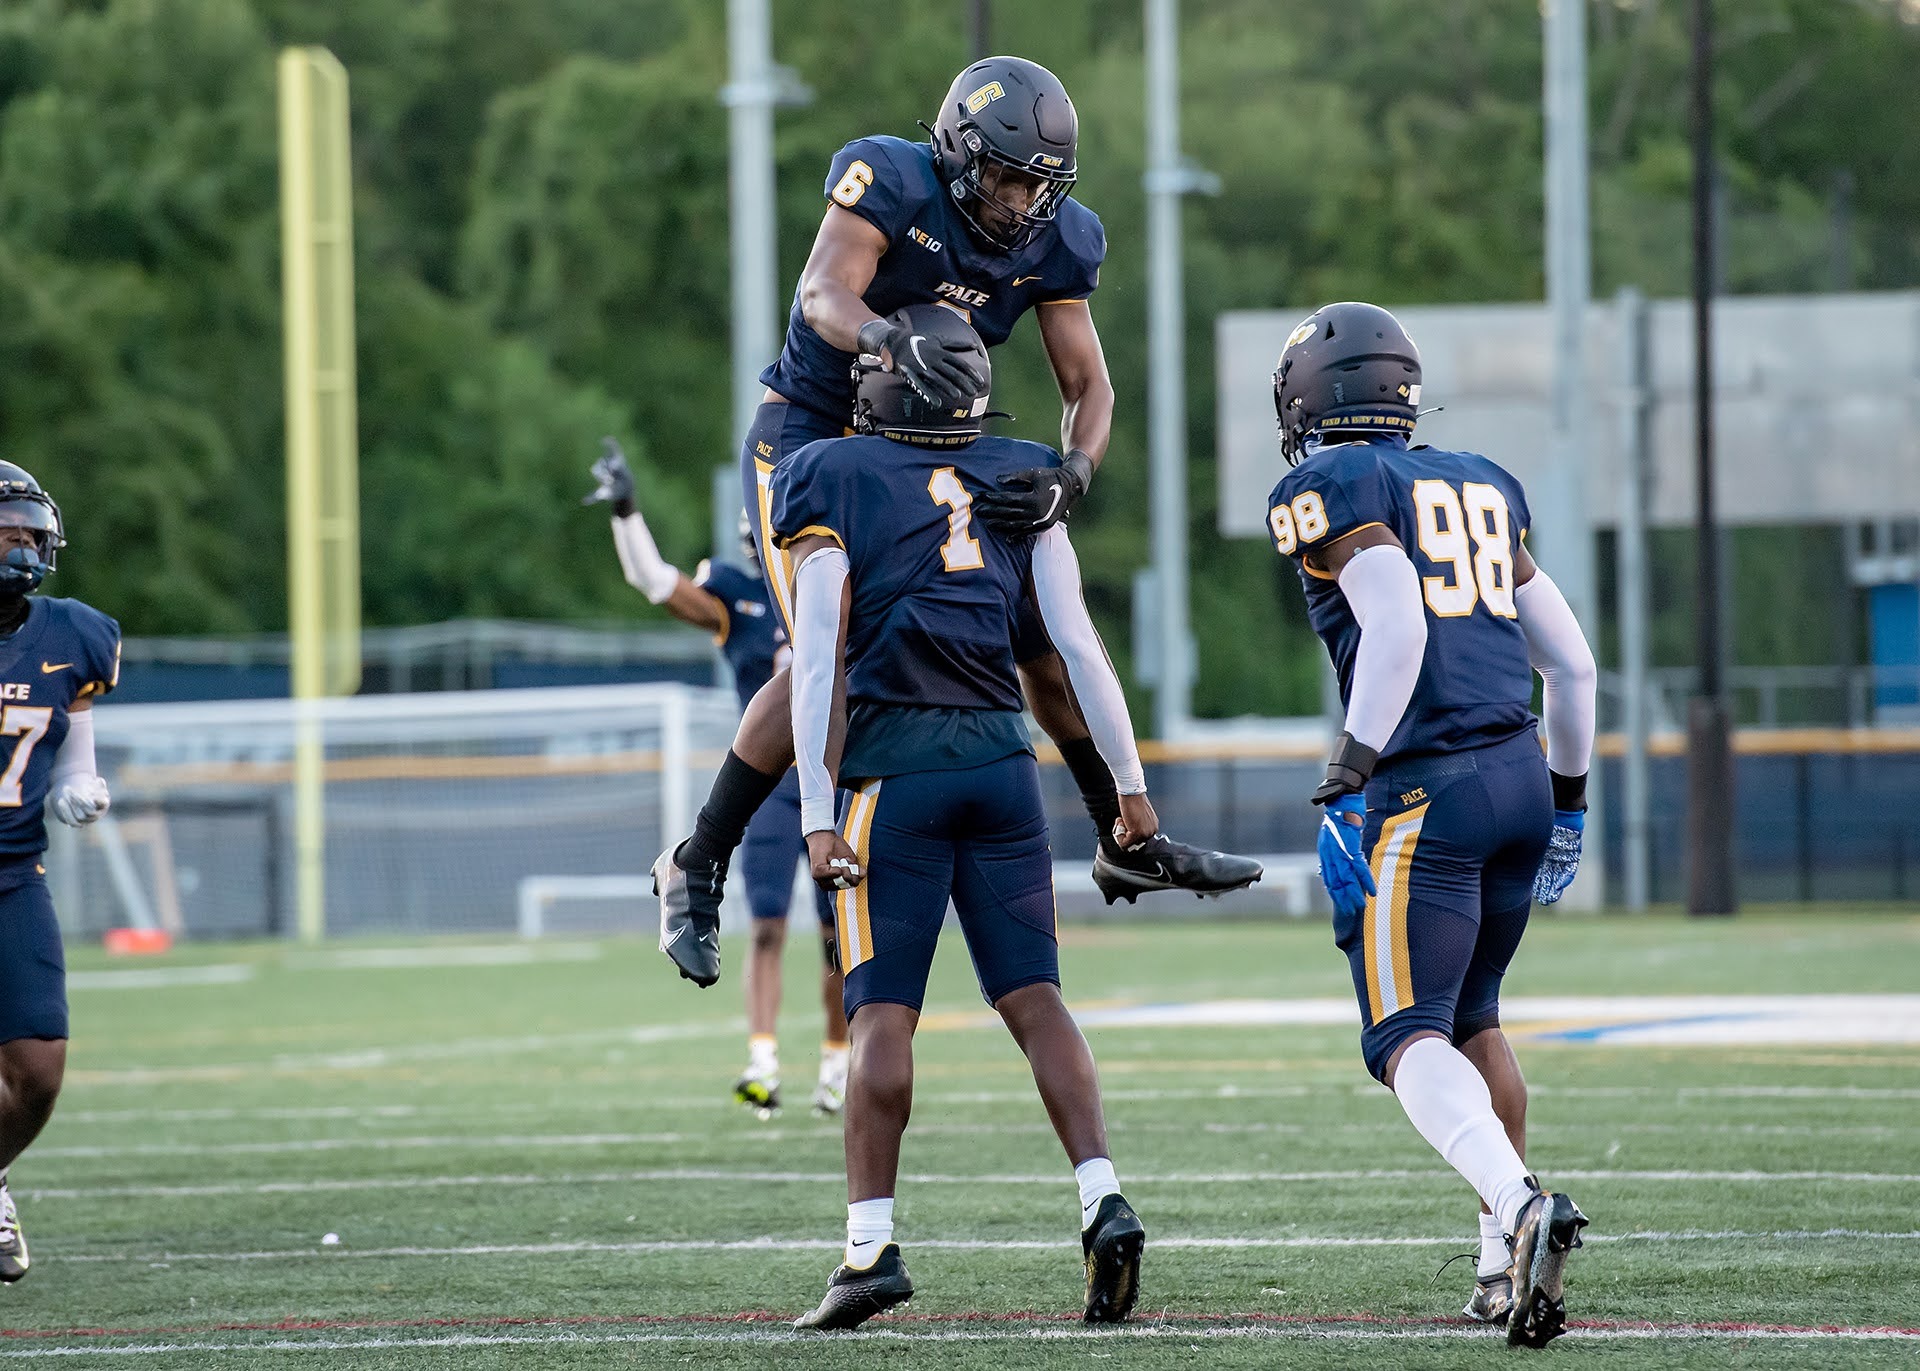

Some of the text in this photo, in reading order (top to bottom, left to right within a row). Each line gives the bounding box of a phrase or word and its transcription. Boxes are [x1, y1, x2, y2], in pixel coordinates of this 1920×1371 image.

[966, 81, 1006, 115] 6
[832, 160, 874, 207] 6
[907, 226, 943, 253] NE10
[934, 281, 990, 307] PACE
[1341, 416, 1349, 425] A
[1351, 415, 1373, 425] WAY
[756, 440, 774, 458] PACE
[927, 466, 985, 572] 1
[1270, 490, 1330, 556] 98
[1412, 479, 1517, 618] 98
[0, 683, 31, 700] CE
[0, 704, 53, 806] 7
[1400, 787, 1427, 806] PACE
